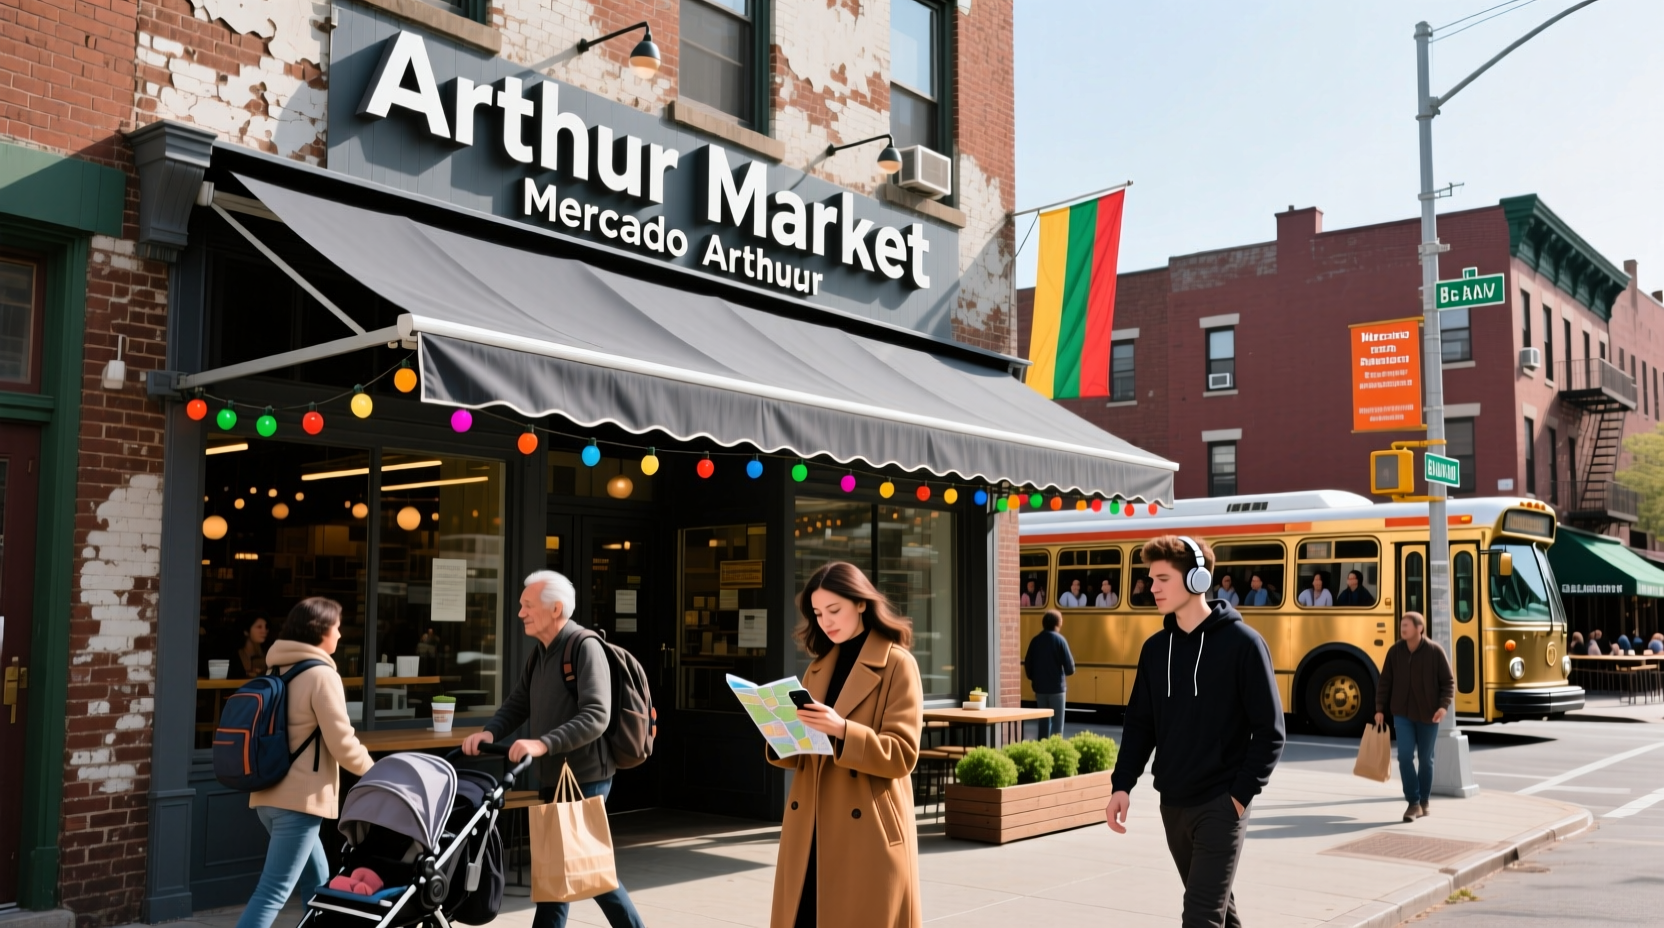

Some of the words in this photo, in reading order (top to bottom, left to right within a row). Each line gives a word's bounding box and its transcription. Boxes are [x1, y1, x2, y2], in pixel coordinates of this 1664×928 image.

[365, 30, 679, 204] Arthur
[707, 144, 931, 290] Market
[524, 177, 688, 258] Mercado
[702, 234, 823, 296] Arthuur
